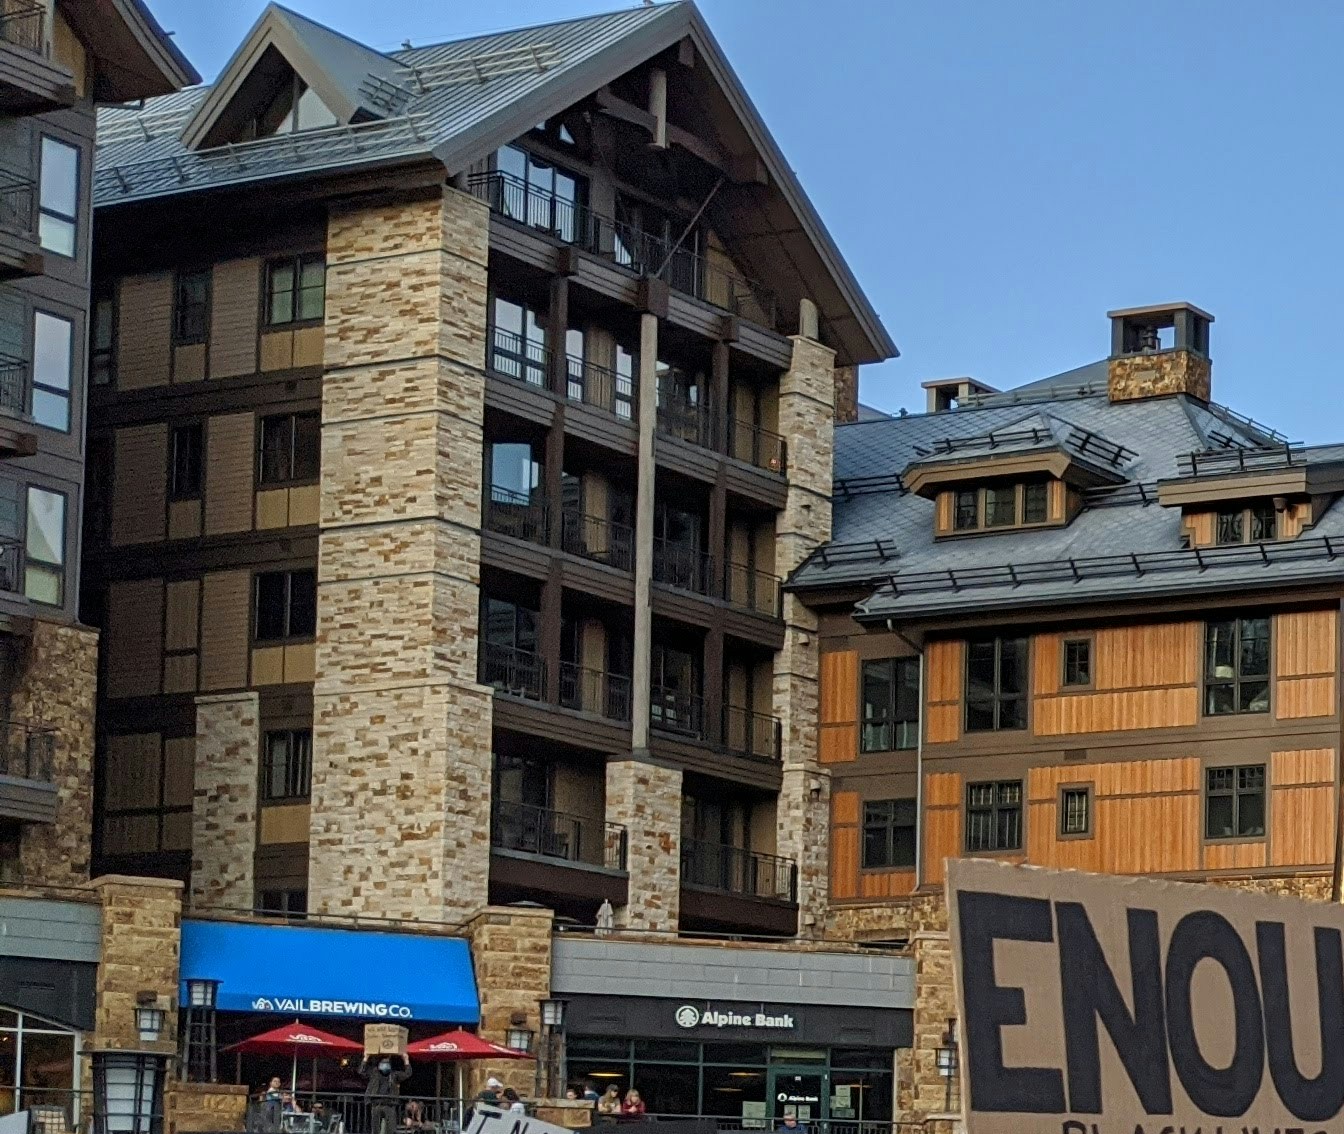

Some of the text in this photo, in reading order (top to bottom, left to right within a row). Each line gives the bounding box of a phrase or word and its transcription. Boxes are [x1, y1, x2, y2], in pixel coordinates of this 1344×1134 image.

[310, 1000, 388, 1017] BREWING
[701, 1011, 794, 1028] Alpine Bank
